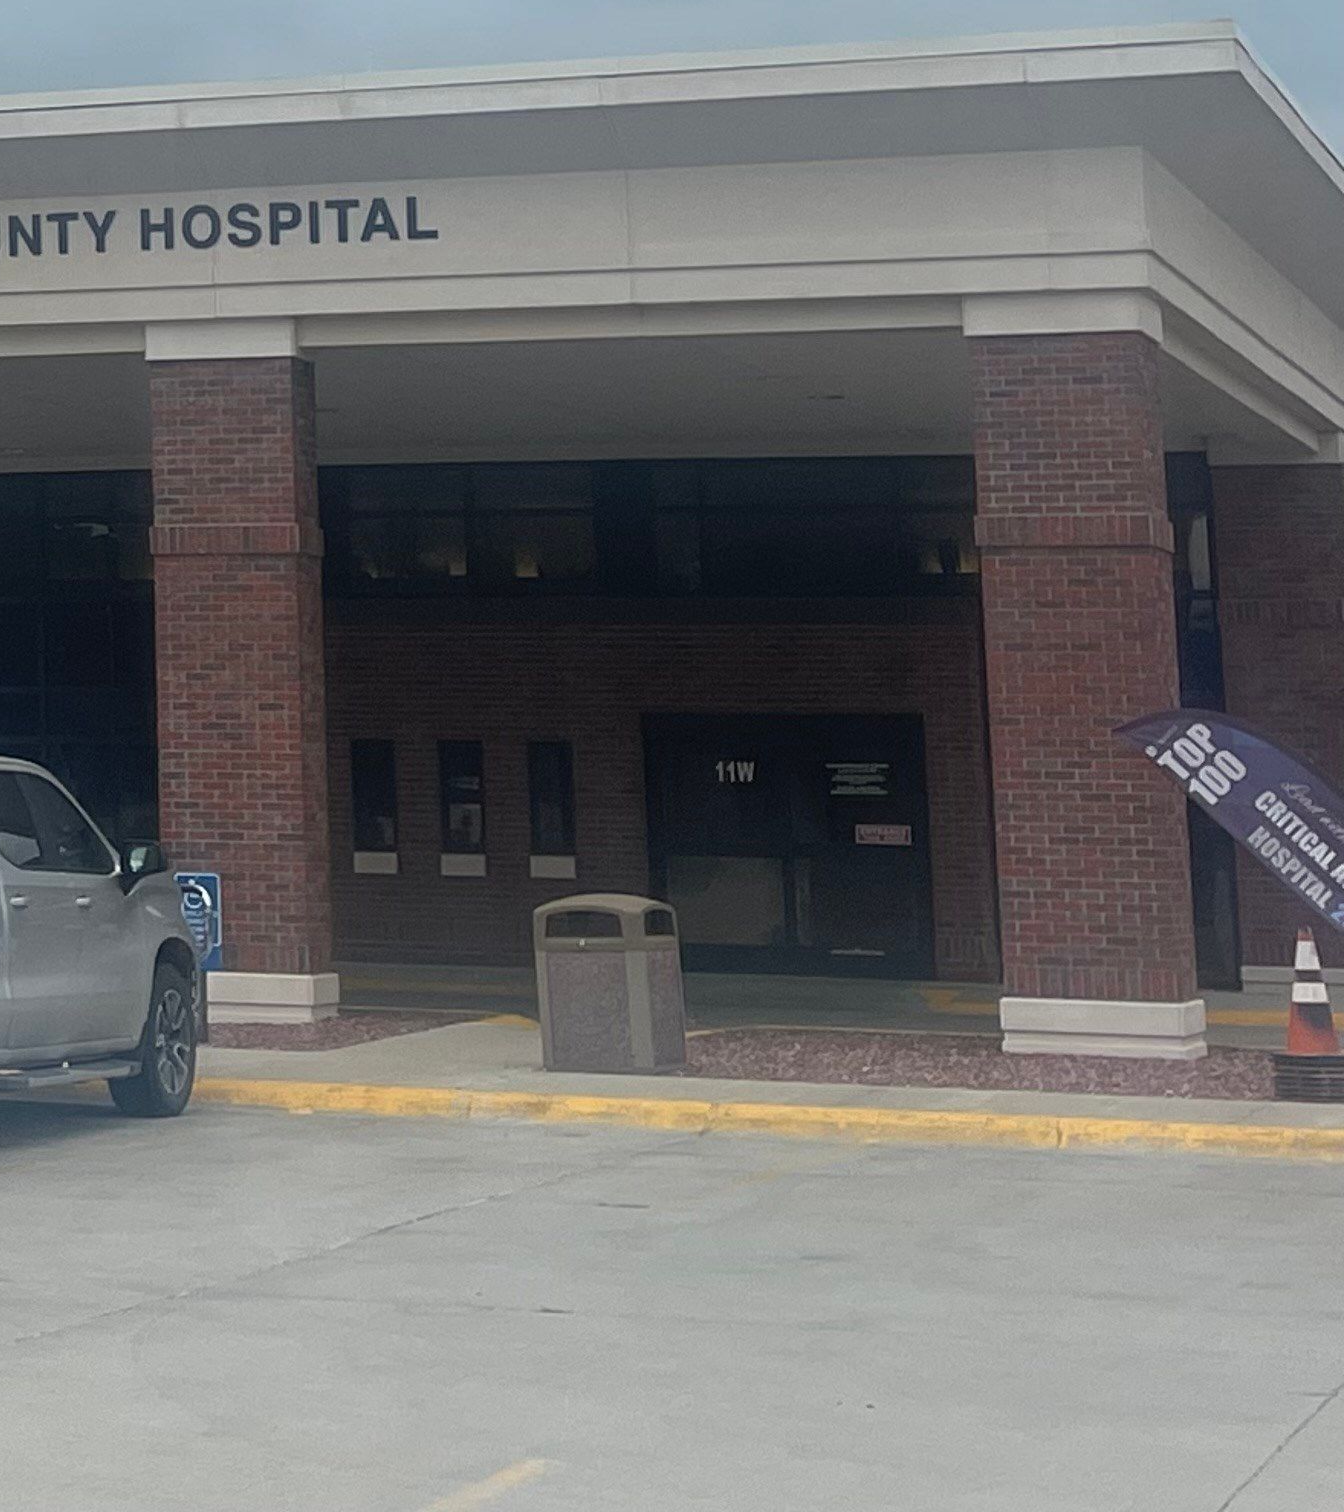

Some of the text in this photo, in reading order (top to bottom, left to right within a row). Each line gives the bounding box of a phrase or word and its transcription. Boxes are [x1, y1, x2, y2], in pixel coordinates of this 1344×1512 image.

[140, 196, 439, 252] HOSPITAL
[715, 760, 755, 783] 11W
[1156, 723, 1216, 780] TOP
[1188, 749, 1247, 805] 100
[1254, 790, 1337, 871] CRITICAL
[1247, 825, 1333, 910] HOSPITAL
